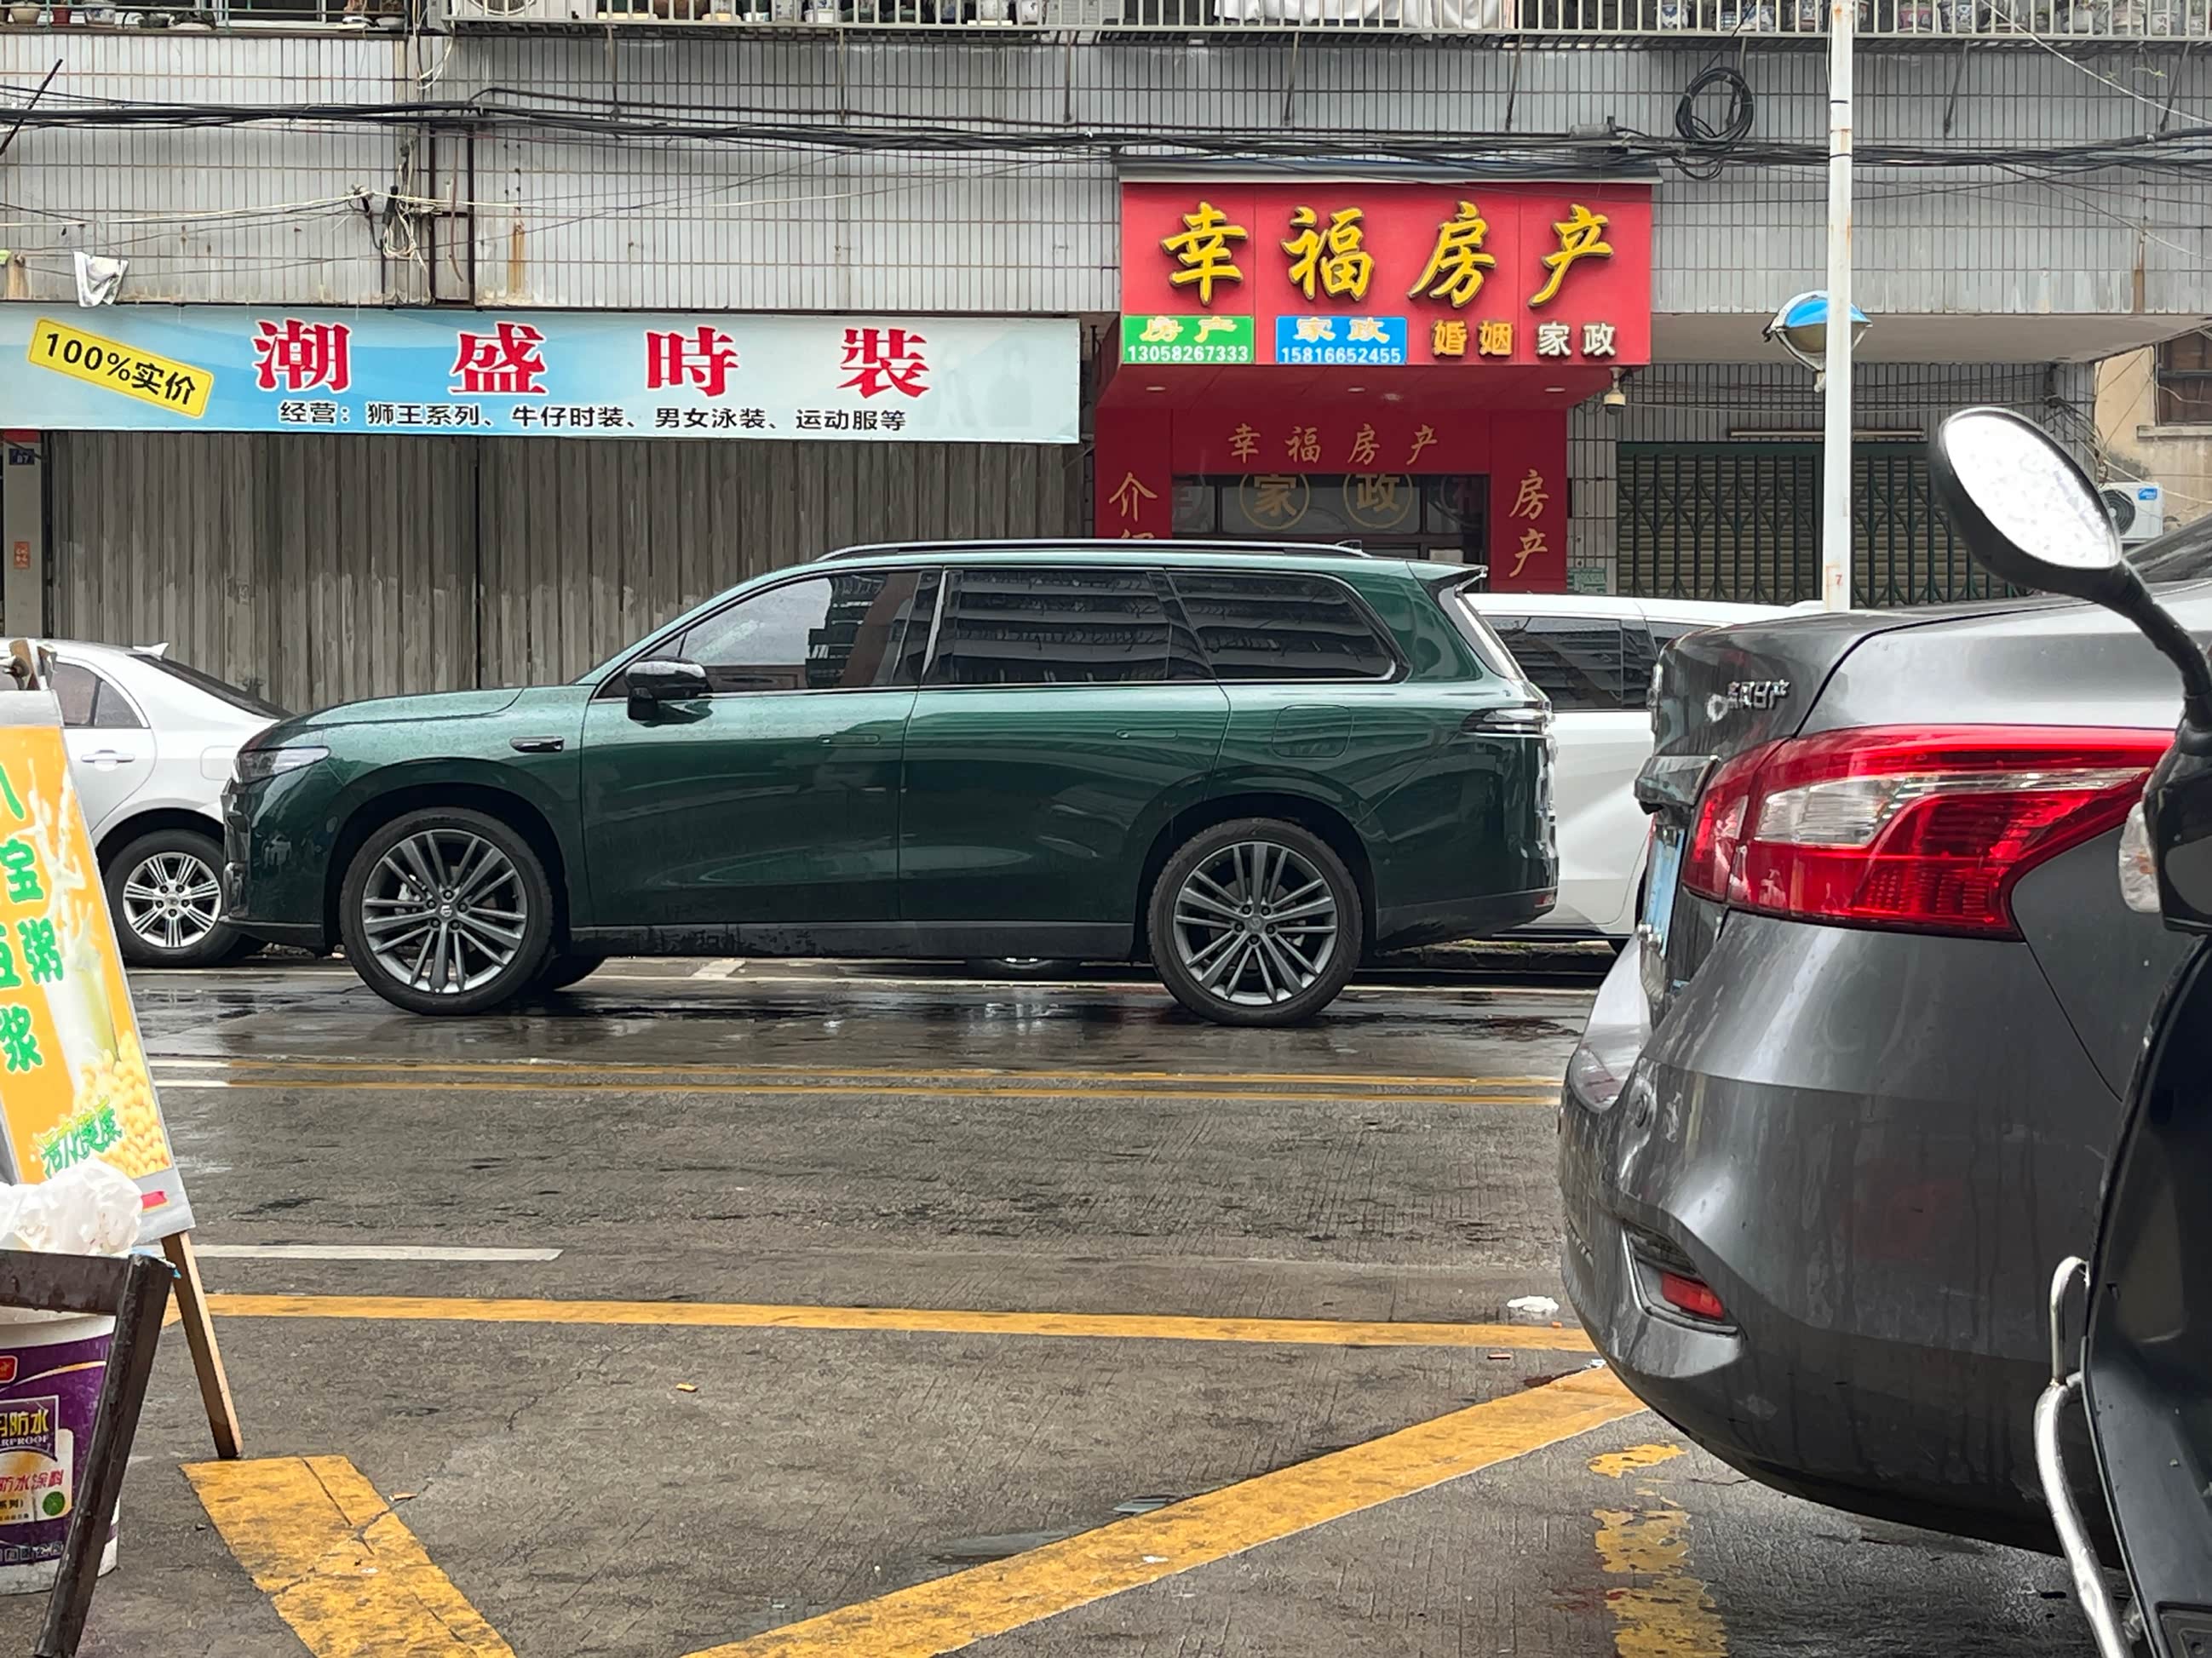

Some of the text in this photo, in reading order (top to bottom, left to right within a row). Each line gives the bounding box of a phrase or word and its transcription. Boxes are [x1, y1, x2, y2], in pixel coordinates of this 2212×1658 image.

[1159, 200, 1615, 309] 幸福房产
[1139, 316, 1237, 343] 房产
[1293, 317, 1390, 343] 家政
[1432, 319, 1617, 357] 婚姻 家政
[45, 332, 197, 406] 100%实价
[254, 318, 931, 399] 潮盛時裝
[1127, 345, 1249, 362] 13058267333
[1281, 347, 1402, 364] 15816652455
[1227, 422, 1439, 466] 幸福房产
[1108, 471, 1158, 538] 介
[1253, 474, 1401, 518] 家政
[1508, 468, 1549, 578] 房产
